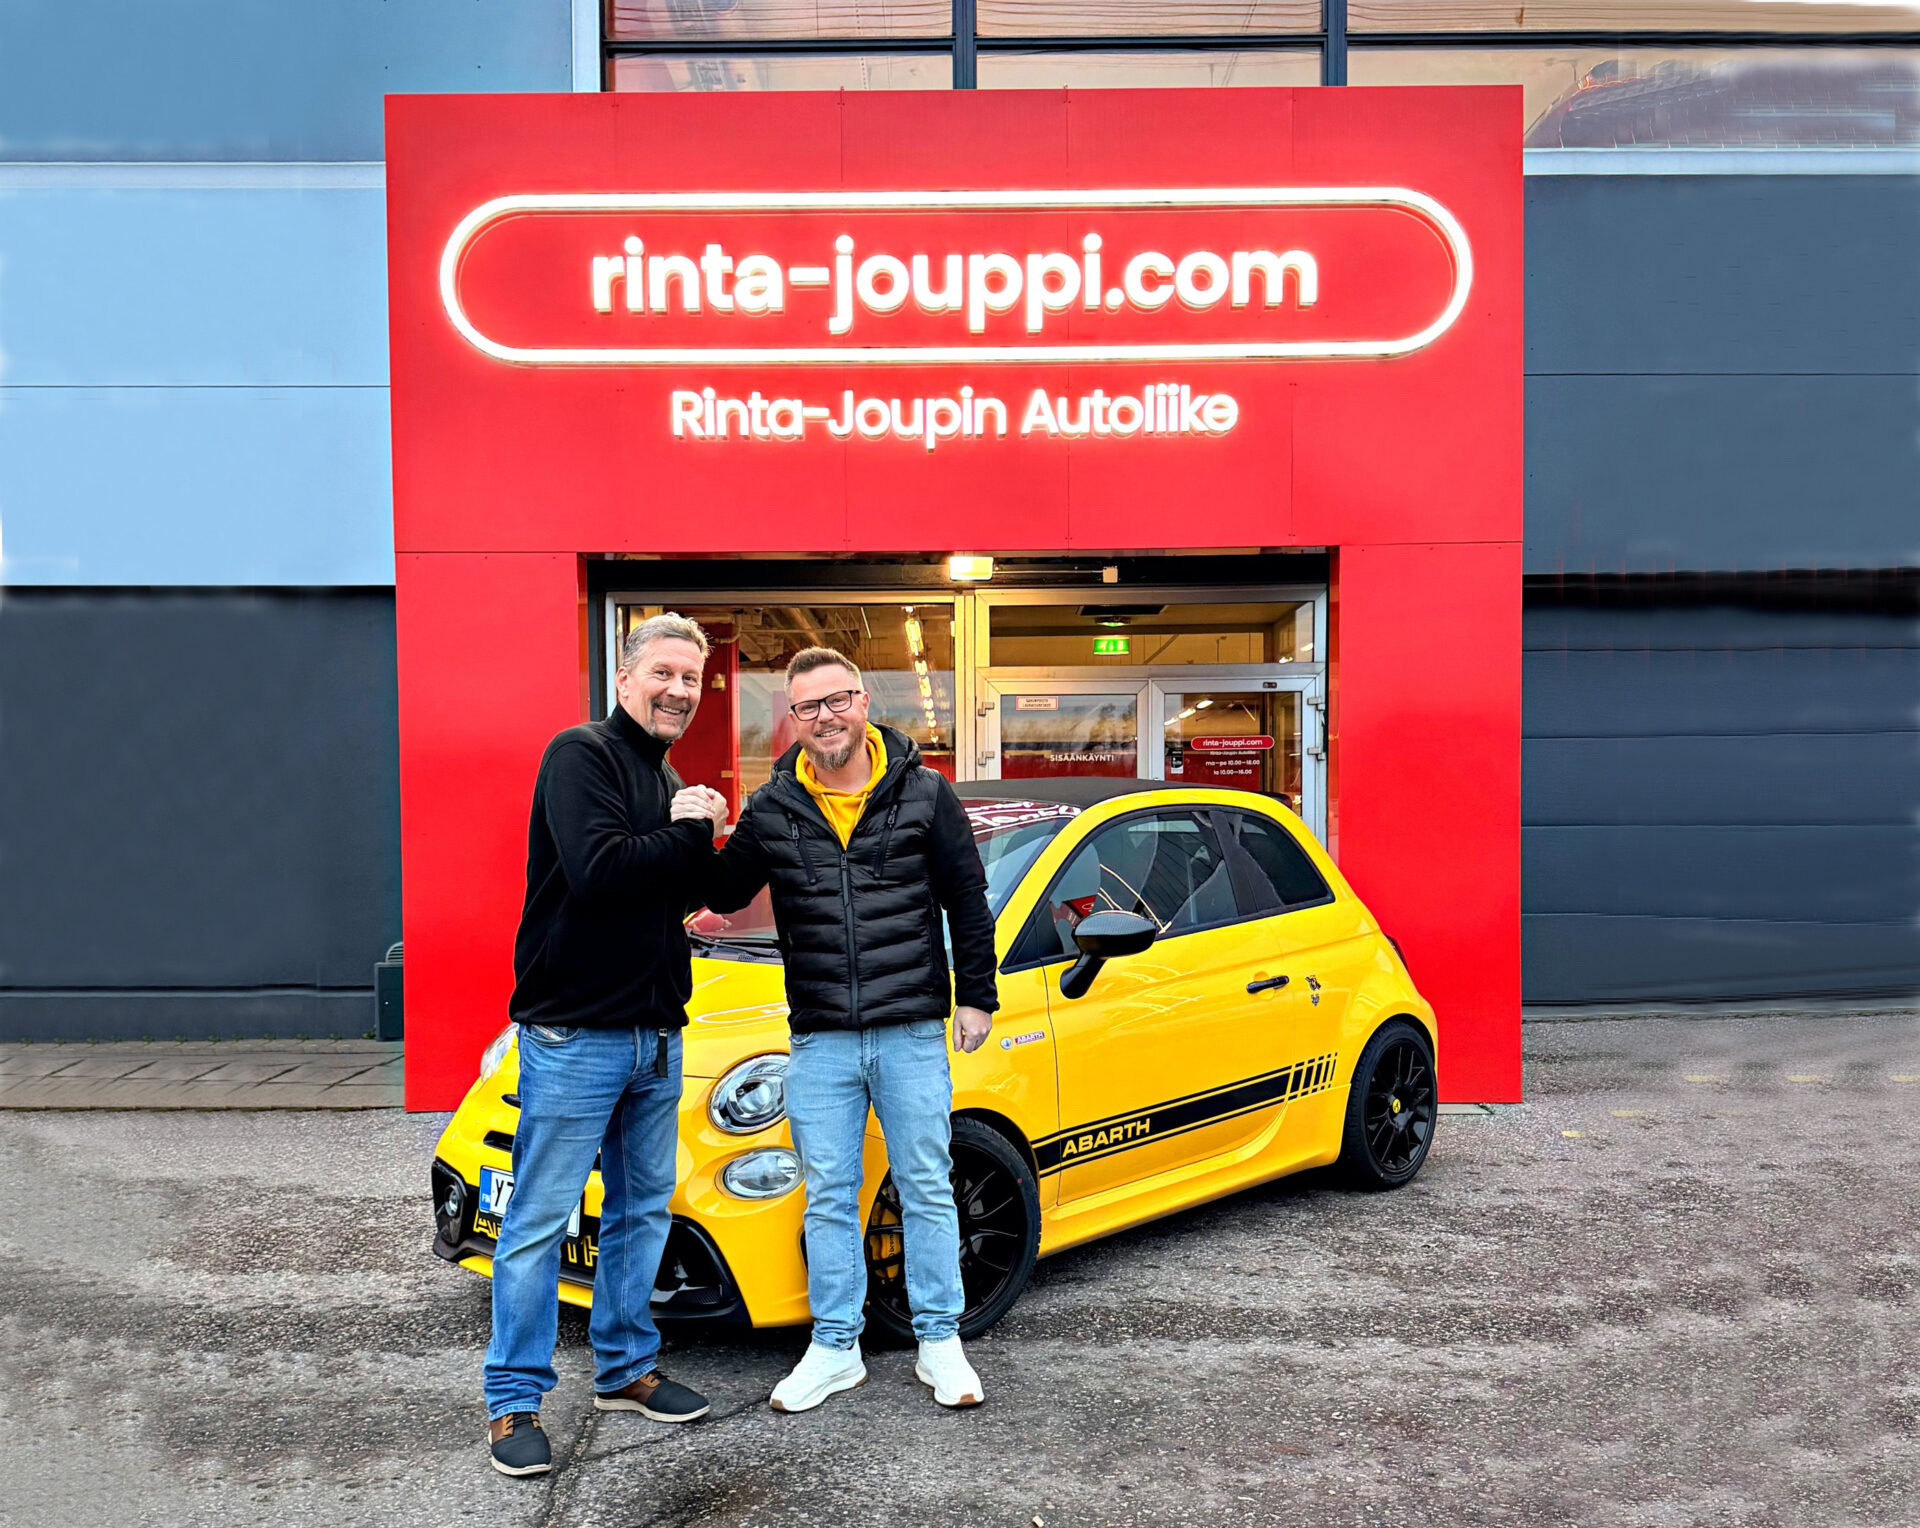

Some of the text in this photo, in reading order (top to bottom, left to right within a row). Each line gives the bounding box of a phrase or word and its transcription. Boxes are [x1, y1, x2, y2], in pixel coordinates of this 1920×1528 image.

[591, 232, 1319, 336] rinta-jouppi.com
[671, 383, 1240, 452] Rinta-Joupin Autoliike
[1049, 753, 1115, 762] SISÄÄNKÄYNTI
[1203, 739, 1262, 747] rinta-jouppi.com
[1061, 1117, 1151, 1158] ABARTH
